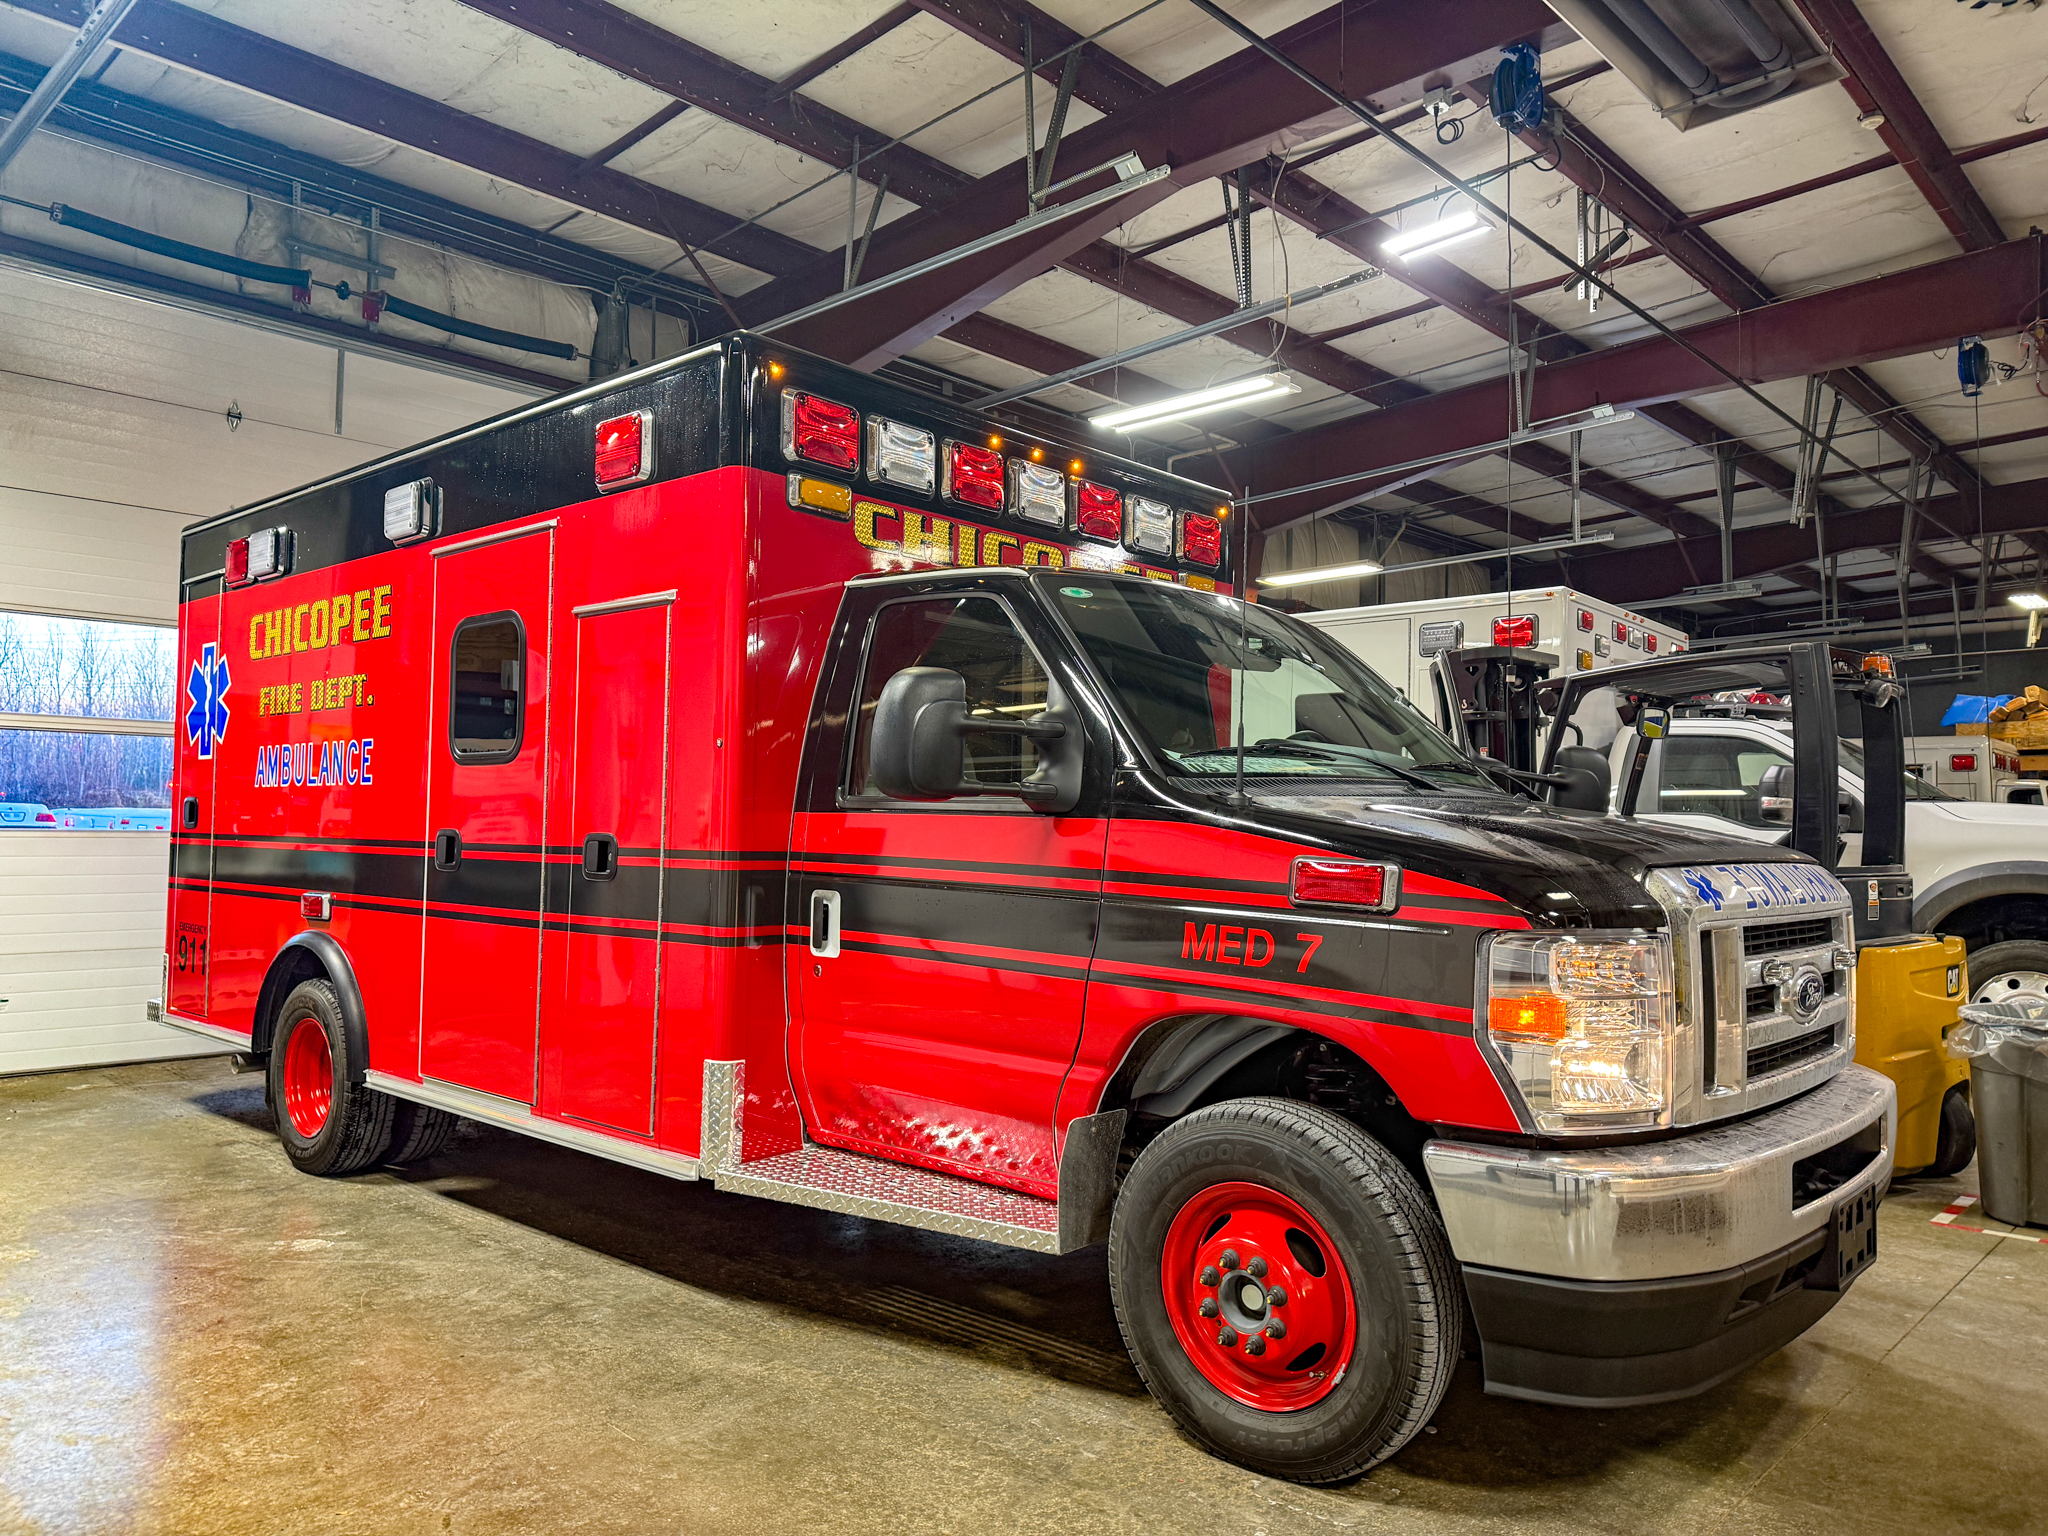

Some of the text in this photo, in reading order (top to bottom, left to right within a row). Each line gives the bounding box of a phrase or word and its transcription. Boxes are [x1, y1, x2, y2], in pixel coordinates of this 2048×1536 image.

[853, 500, 1176, 581] CHICO
[250, 584, 393, 660] CHICOPEE
[259, 673, 375, 717] FIRE DEPT.
[254, 738, 374, 788] AMBULANCE
[180, 922, 207, 935] EMERGENCY
[1180, 922, 1324, 973] MED 7
[179, 935, 206, 975] 911
[1947, 968, 1959, 994] CAT
